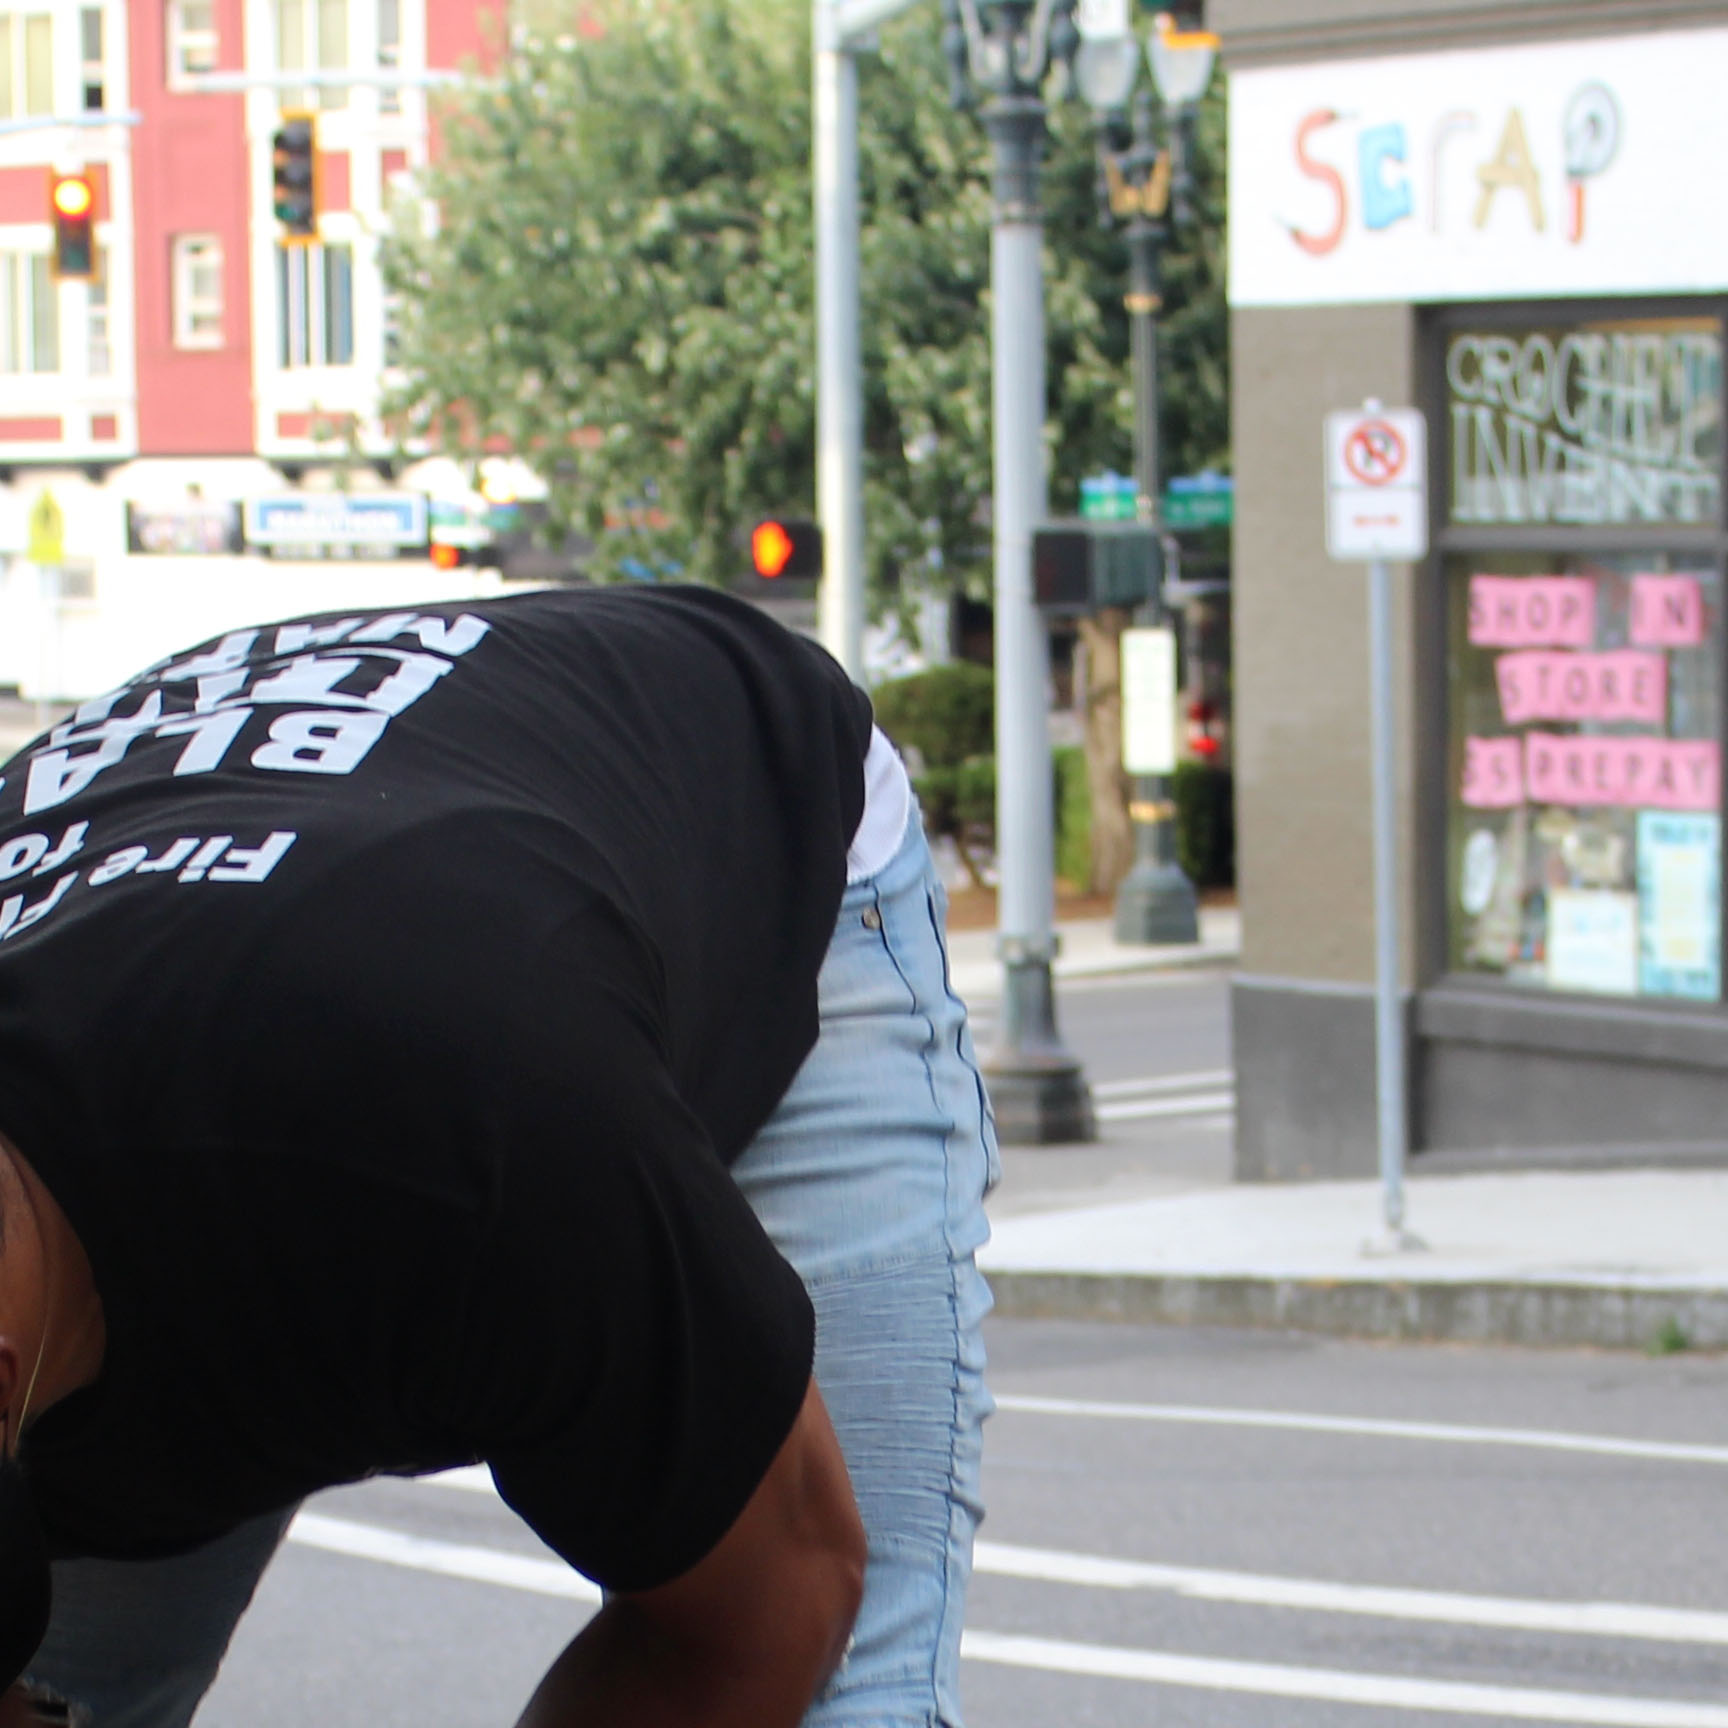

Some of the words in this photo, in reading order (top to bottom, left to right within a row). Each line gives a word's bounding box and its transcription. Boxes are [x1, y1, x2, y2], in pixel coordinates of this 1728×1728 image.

[1446, 333, 1720, 474] CROCHET
[1450, 402, 1720, 523] INVENT
[1471, 594, 1581, 631] SHOP
[1632, 592, 1691, 629] IN
[1500, 662, 1651, 703] STORE
[1537, 750, 1714, 792] PREPAY
[87, 830, 297, 886] Fire
